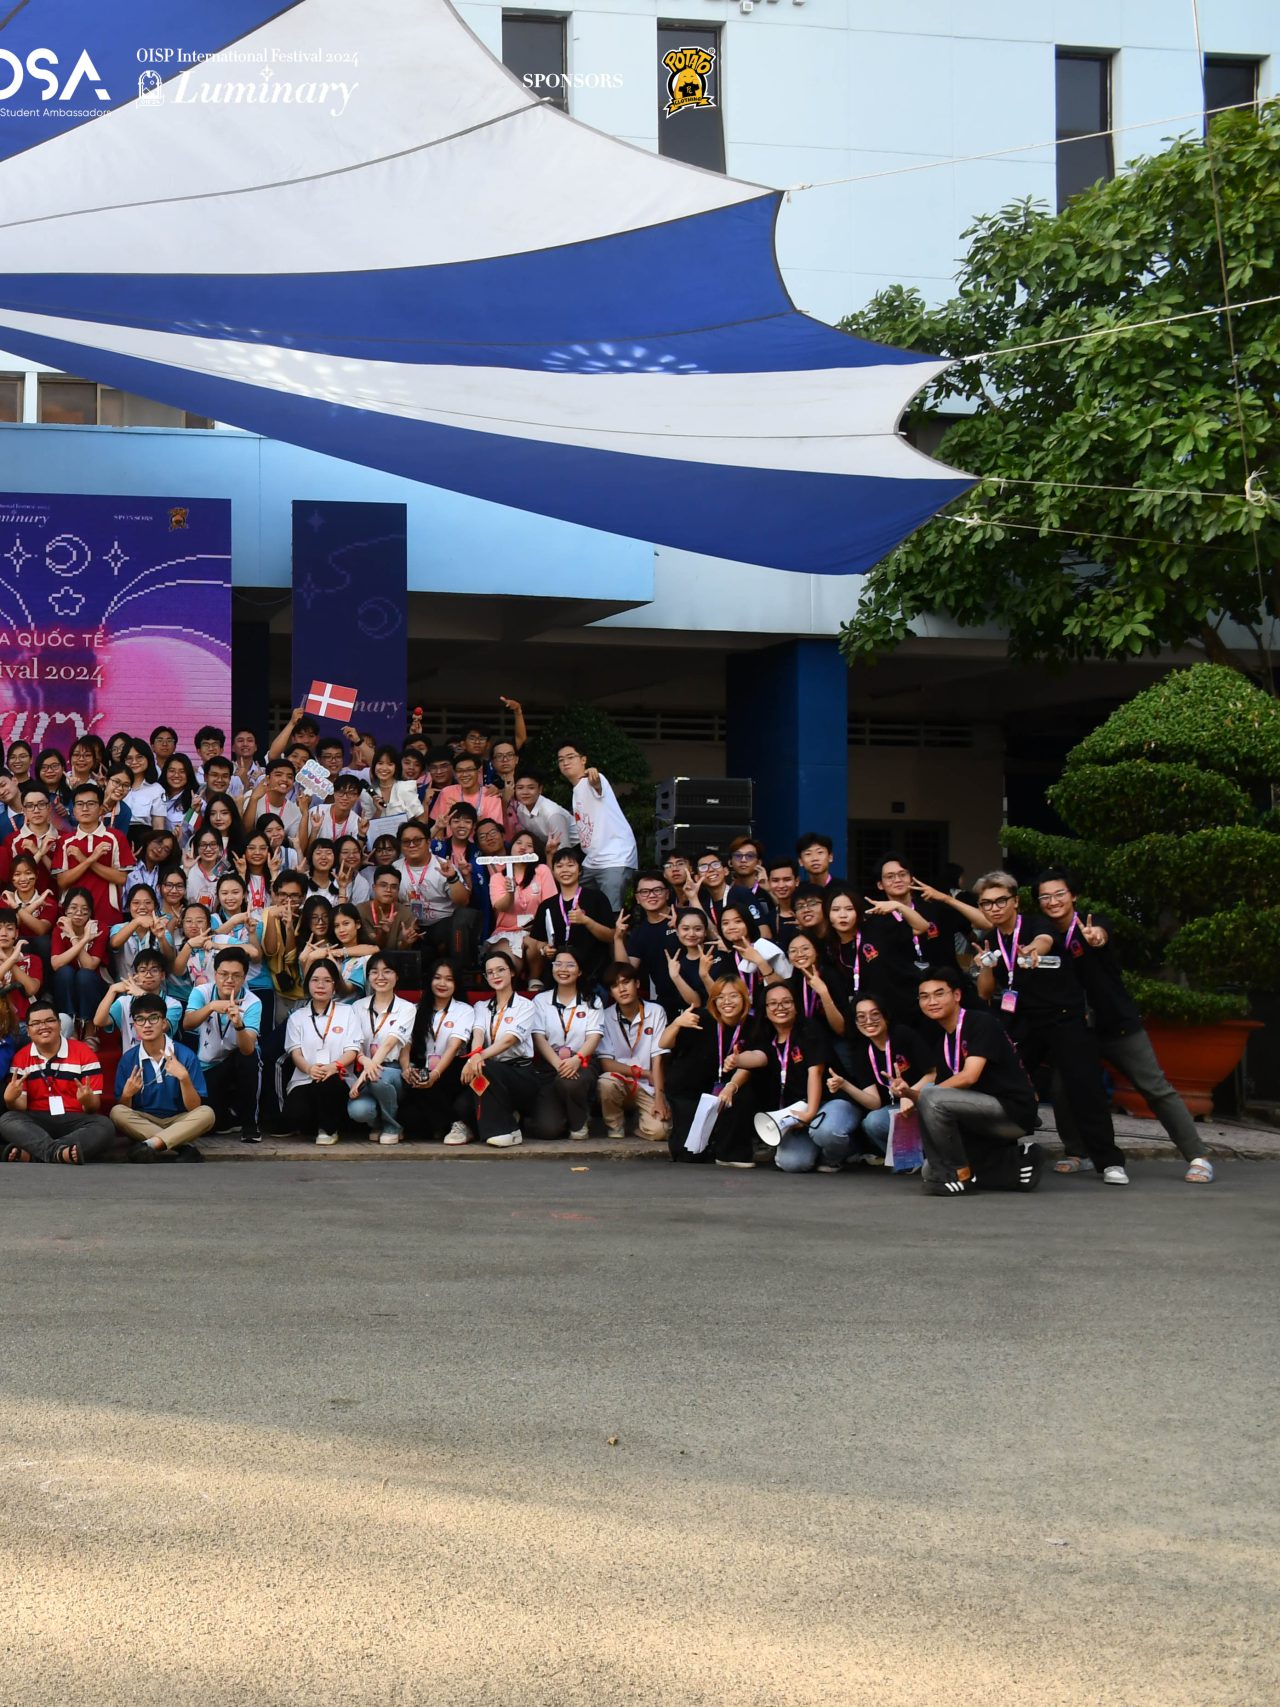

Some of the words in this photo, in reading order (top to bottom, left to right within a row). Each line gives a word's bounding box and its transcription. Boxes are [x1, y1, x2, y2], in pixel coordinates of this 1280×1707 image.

[17, 629, 75, 647] QUỐC
[82, 629, 105, 648] TẾ
[44, 664, 105, 687] 2024
[353, 700, 403, 720] nary
